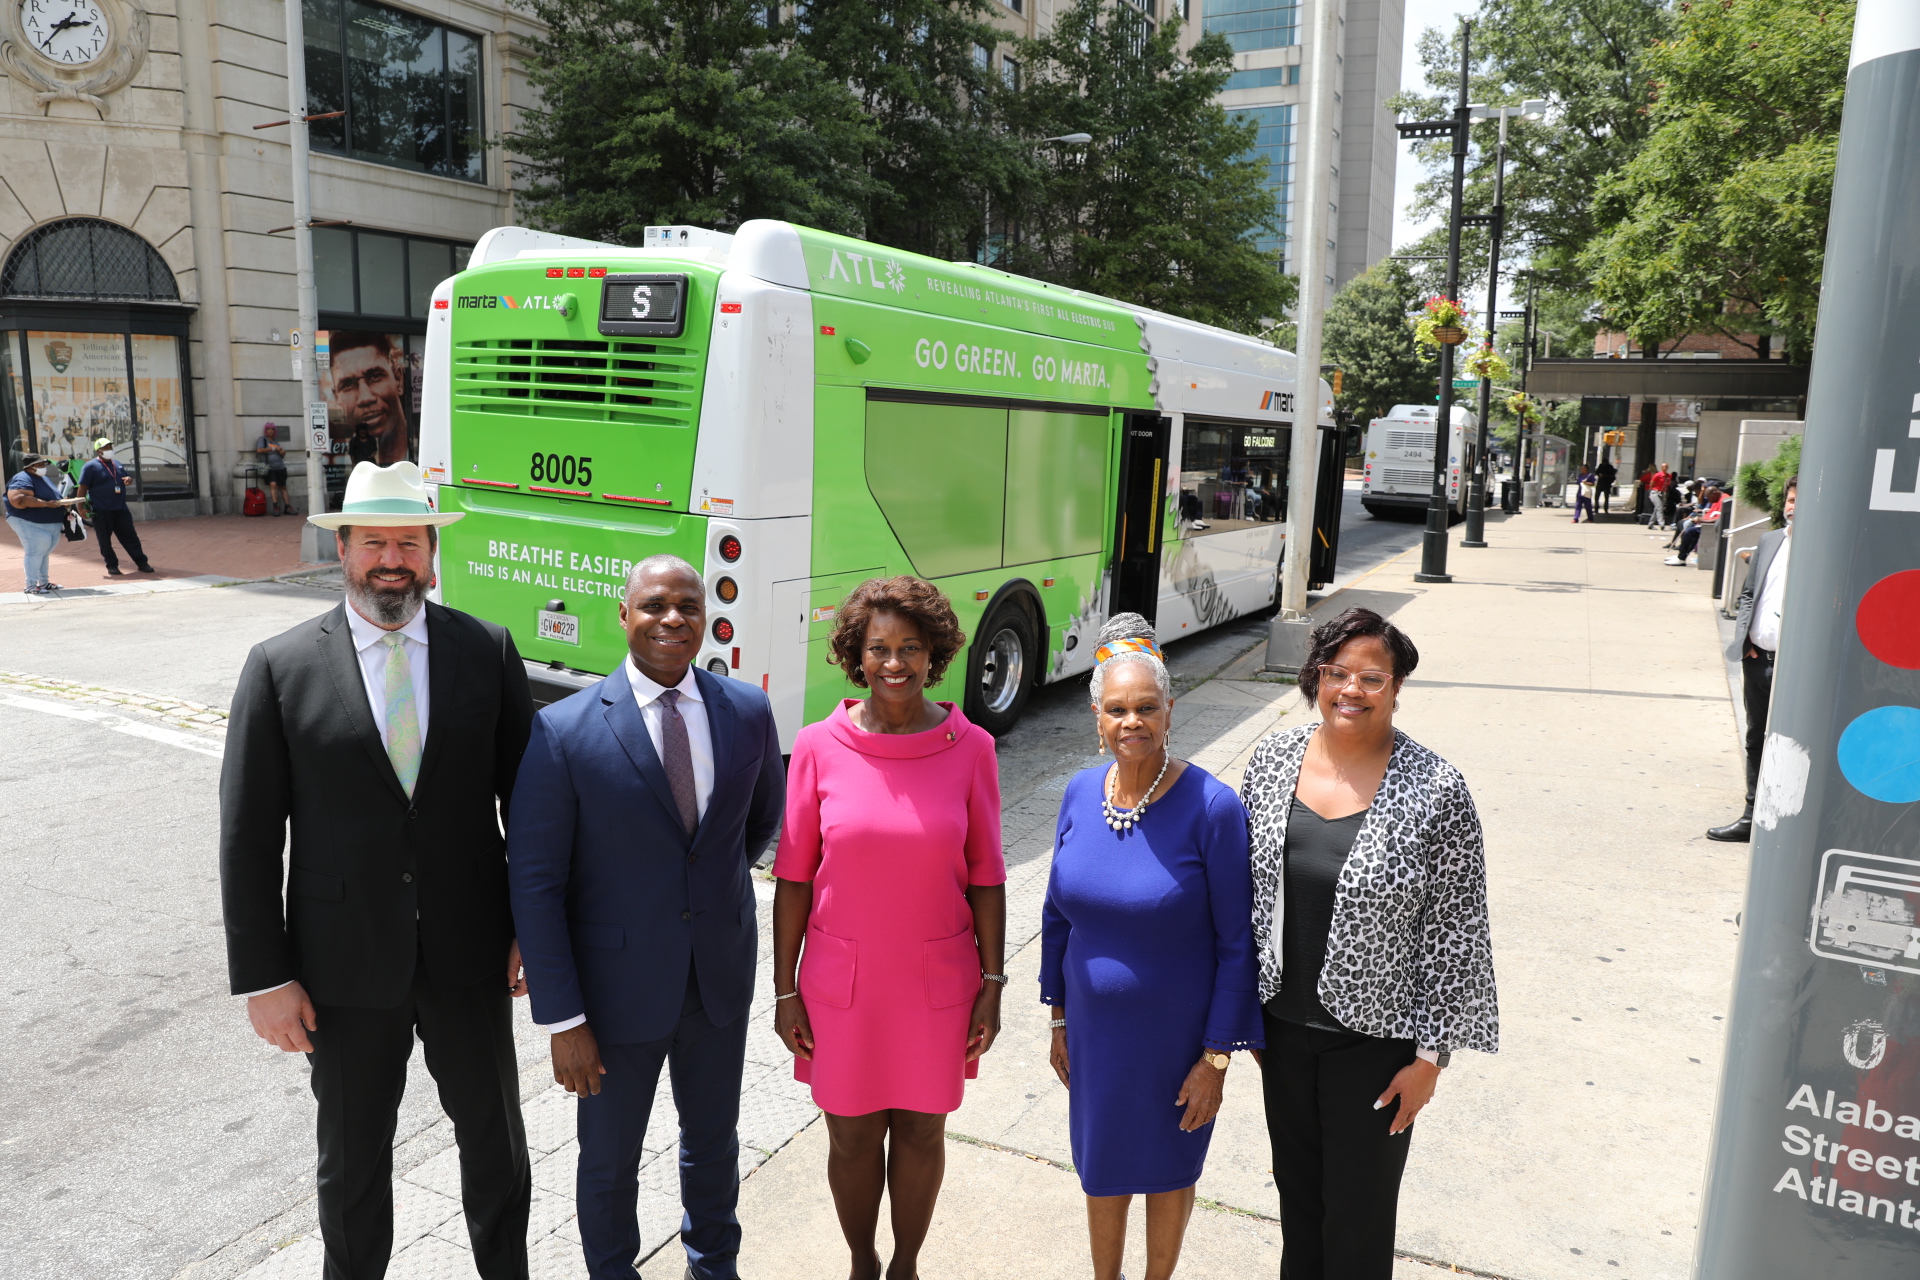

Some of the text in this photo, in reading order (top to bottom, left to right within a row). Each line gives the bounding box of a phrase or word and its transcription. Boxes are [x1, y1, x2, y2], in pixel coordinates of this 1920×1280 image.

[829, 248, 886, 289] ATL
[458, 294, 498, 308] marta
[523, 296, 550, 310] ATL
[632, 286, 652, 318] S
[927, 278, 1116, 332] REVEALING ATLANTA'S FIRST ALL ELECTRIC BUS
[916, 338, 1110, 388] GO GREEN. GO MARTA.
[1274, 392, 1294, 412] mart
[1244, 436, 1251, 447] GO
[530, 452, 592, 486] 8005
[488, 540, 632, 578] BREATHE EASIER
[468, 560, 626, 600] THIS IS AN ALL ELECTRIC
[1786, 1084, 1920, 1141] Alaba
[1781, 1124, 1920, 1186] Street
